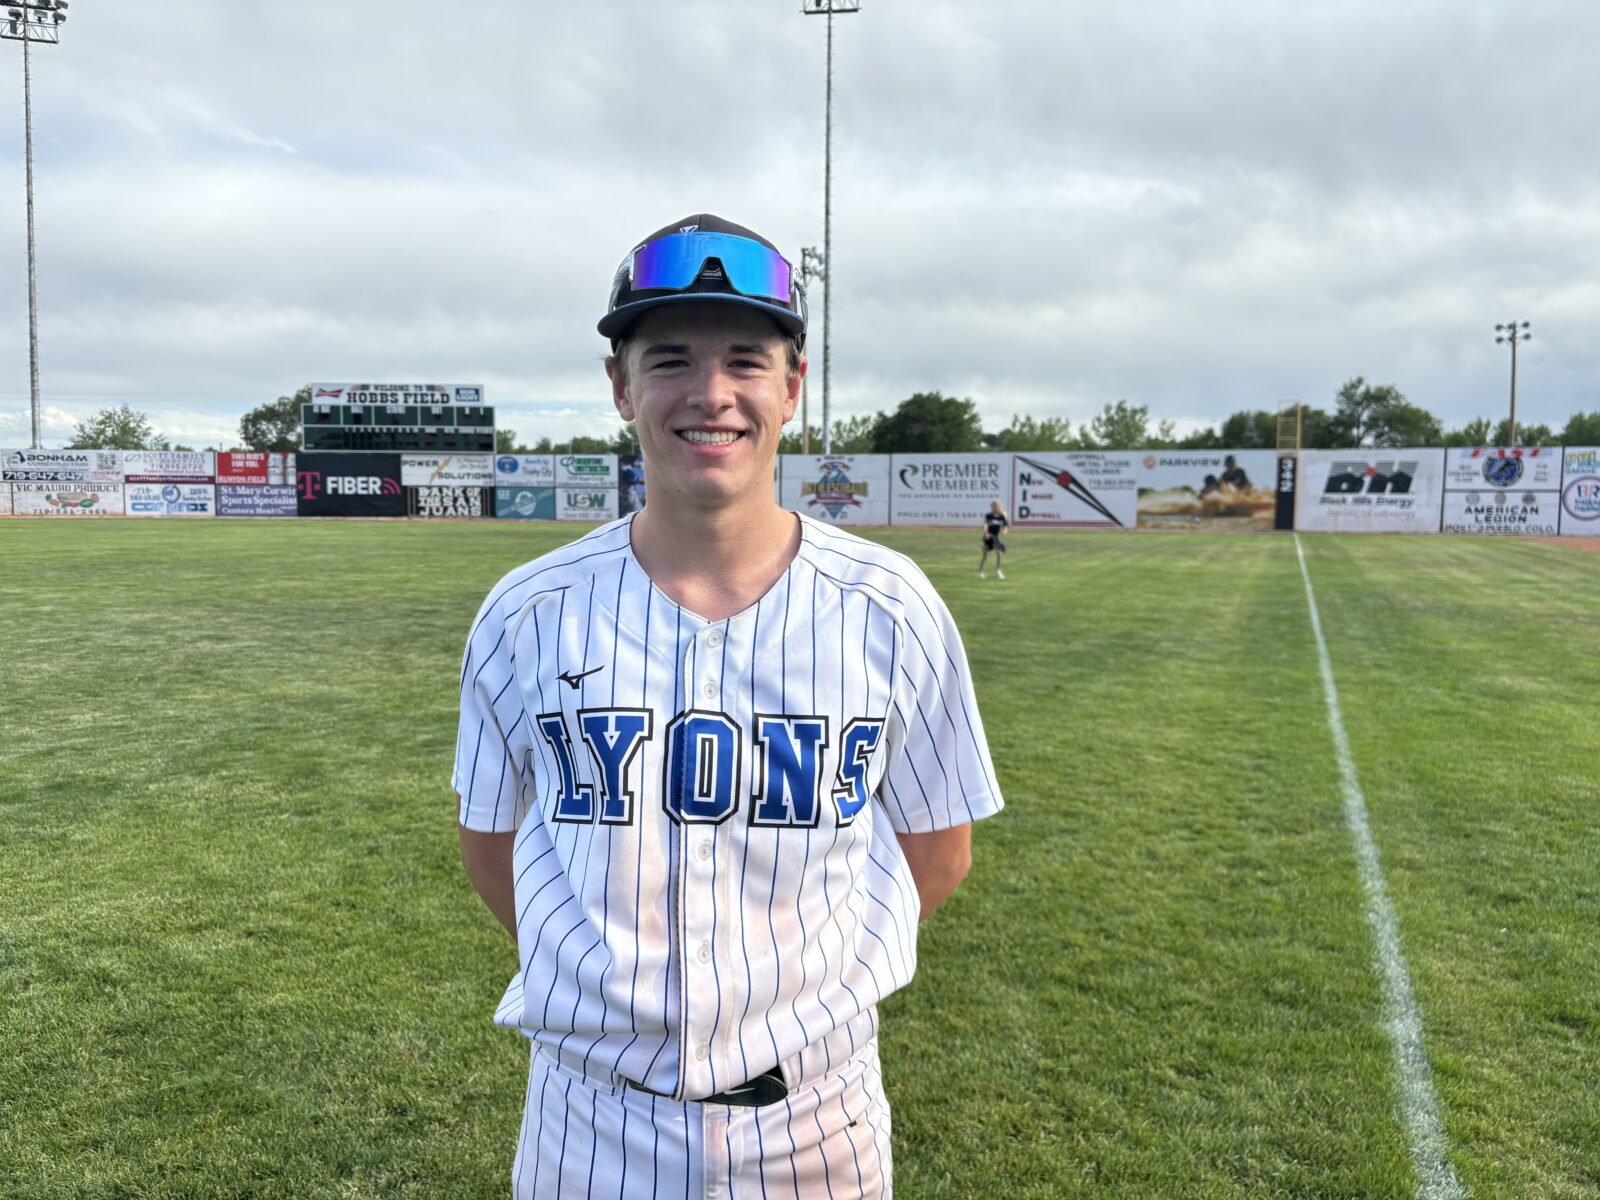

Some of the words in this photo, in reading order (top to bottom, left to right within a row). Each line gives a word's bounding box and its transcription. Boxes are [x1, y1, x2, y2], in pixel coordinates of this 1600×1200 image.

[347, 392, 399, 404] HOBBS
[403, 392, 450, 404] FIELD
[27, 454, 88, 462] BONHAM
[1159, 458, 1221, 466] PARKVIEW
[921, 463, 1000, 478] PREMIER
[247, 475, 267, 483] FIELD
[16, 484, 33, 492] VIC
[36, 484, 71, 492] MAURO
[74, 484, 119, 492] PRODUCE
[236, 486, 261, 495] Mary
[326, 476, 382, 495] FIBER
[921, 480, 1000, 491] MEMBERS
[418, 487, 464, 496] BANK
[466, 487, 481, 496] OF
[221, 495, 252, 506] Sports
[443, 496, 481, 507] SAN
[567, 493, 606, 508] USW
[1319, 496, 1347, 505] Black
[1351, 496, 1372, 505] Hills
[1375, 497, 1414, 509] Energy
[419, 506, 481, 517] JUANS
[1464, 505, 1540, 514] AMERICAN
[1474, 515, 1527, 523] LEGION
[1445, 524, 1472, 533] POST
[536, 707, 886, 828] LYONS
